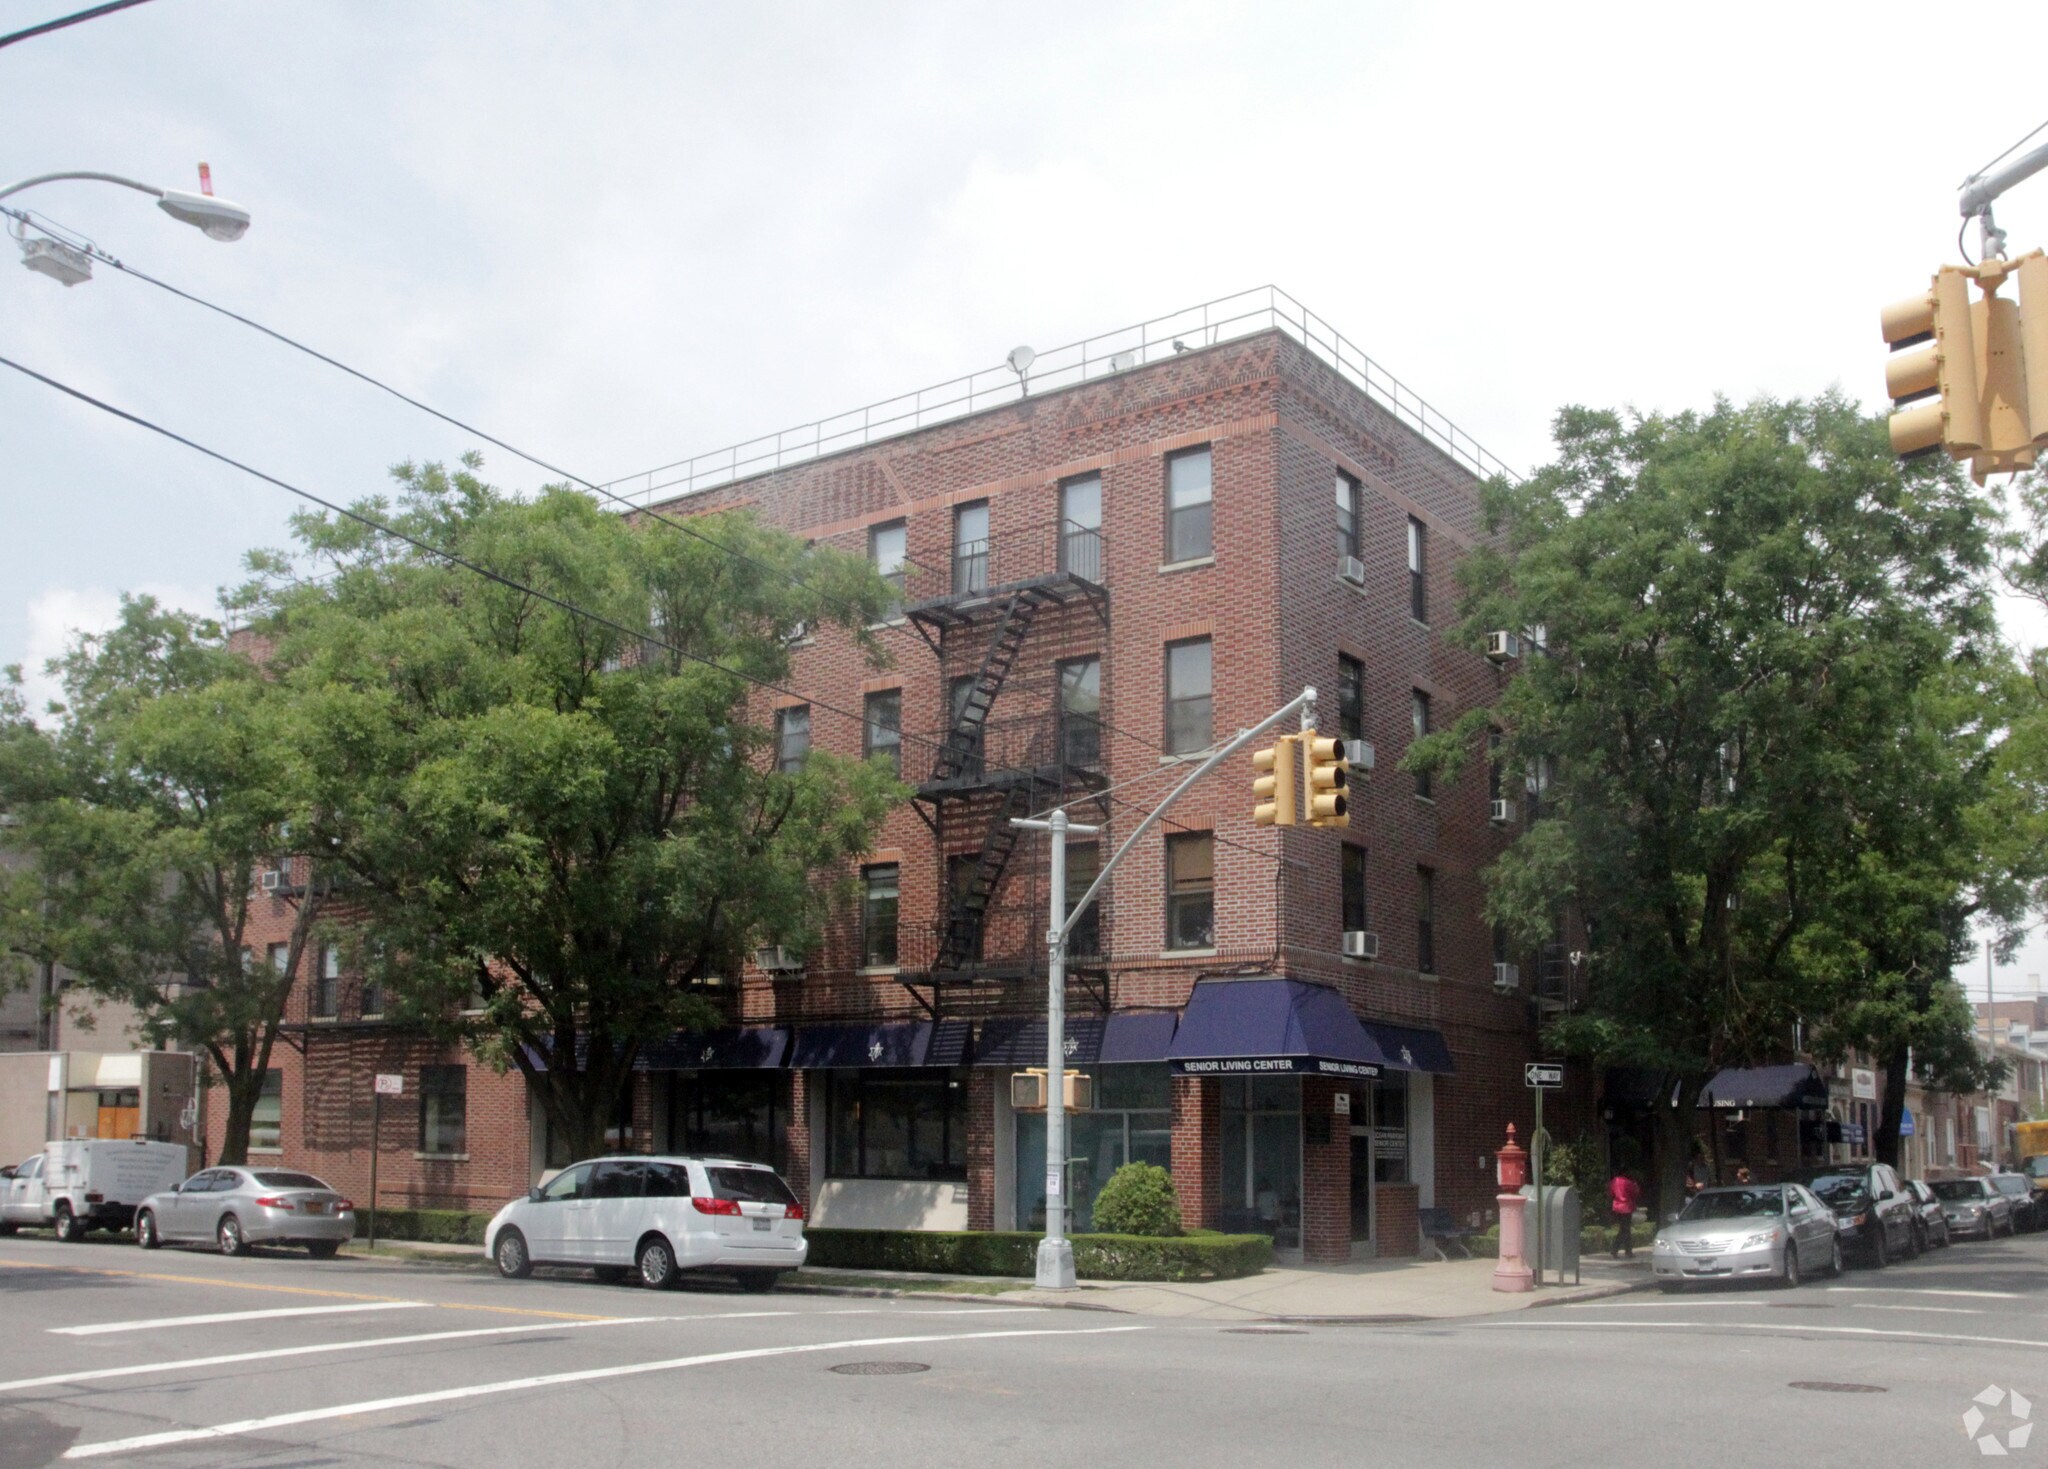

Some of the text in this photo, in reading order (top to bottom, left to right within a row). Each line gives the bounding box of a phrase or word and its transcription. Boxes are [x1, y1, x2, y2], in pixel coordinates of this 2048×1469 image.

[1184, 1059, 1293, 1072] SENIOR LIVING CENTER
[1319, 1061, 1379, 1076] SENIOR LIVING CENTER
[1530, 1071, 1559, 1079] ONE WAY
